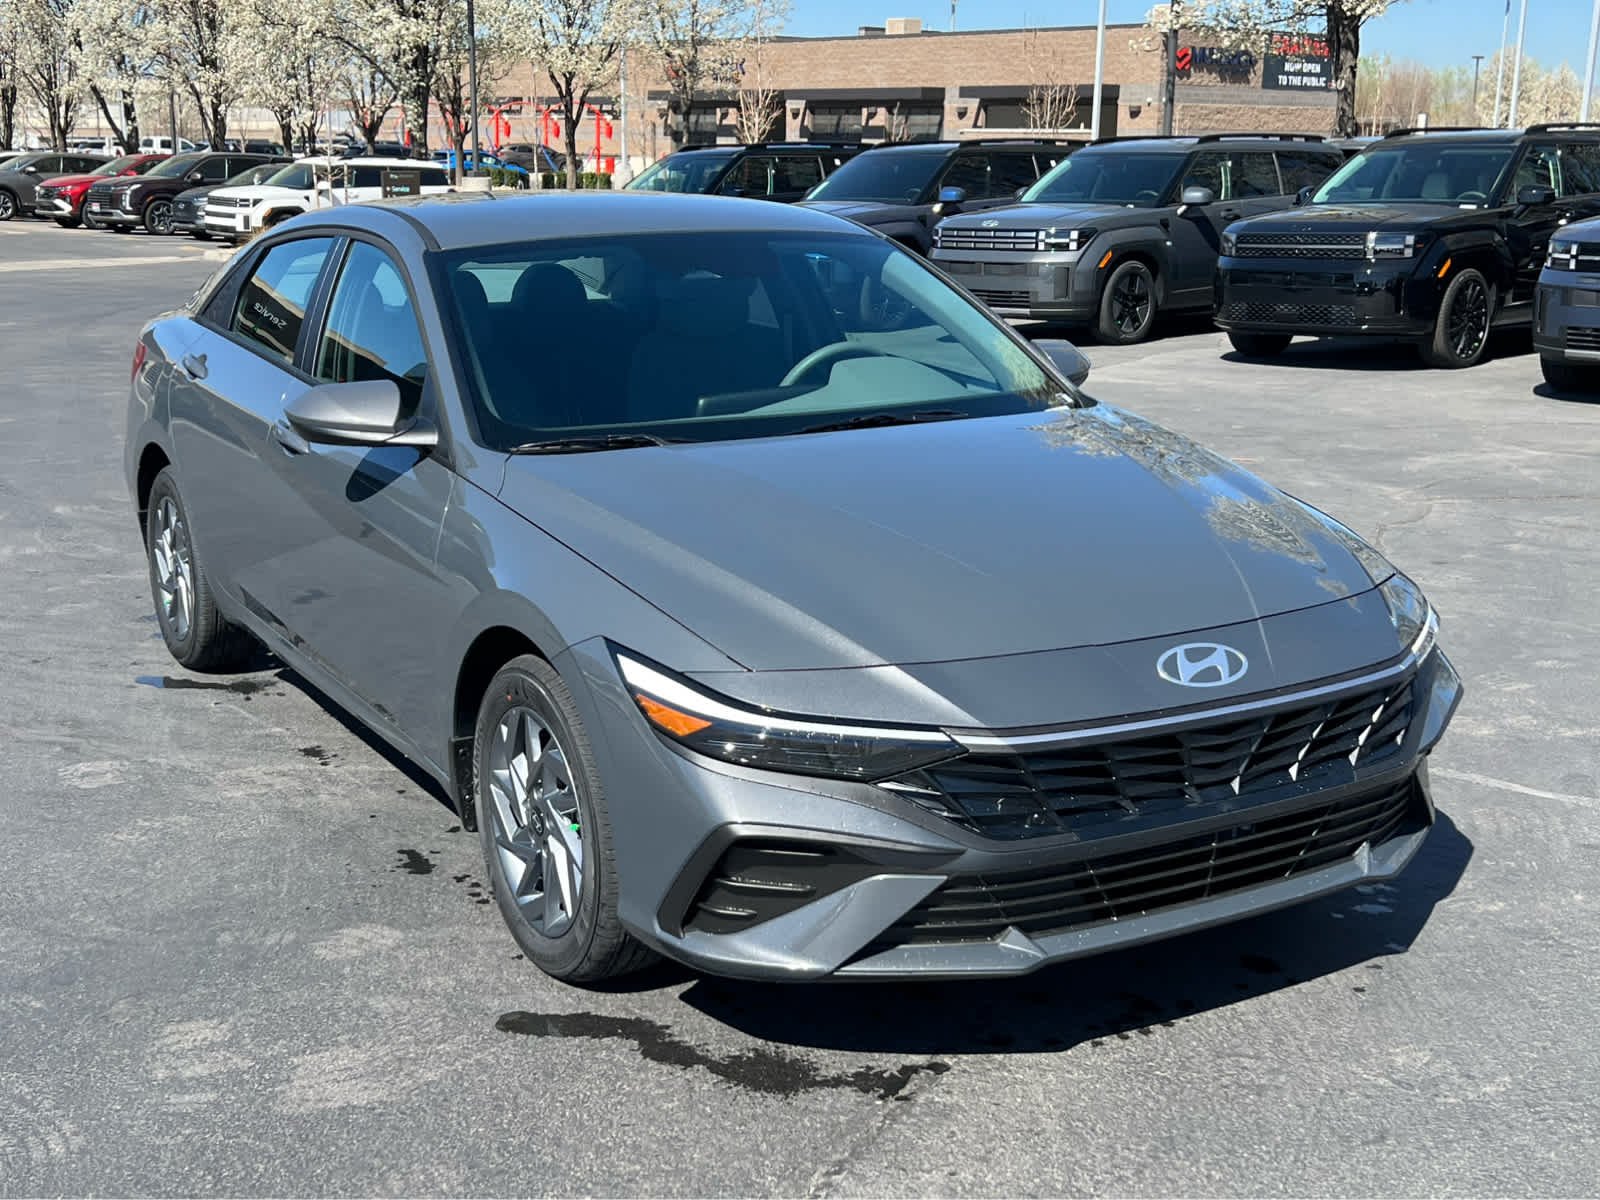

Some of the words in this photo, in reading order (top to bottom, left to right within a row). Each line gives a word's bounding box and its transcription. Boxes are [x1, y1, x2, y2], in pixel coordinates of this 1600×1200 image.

[1284, 62, 1302, 72] NOW
[1303, 62, 1321, 73] OPEN
[1278, 75, 1287, 85] TO
[1288, 75, 1302, 86] THE
[1303, 76, 1327, 87] PUBLIC
